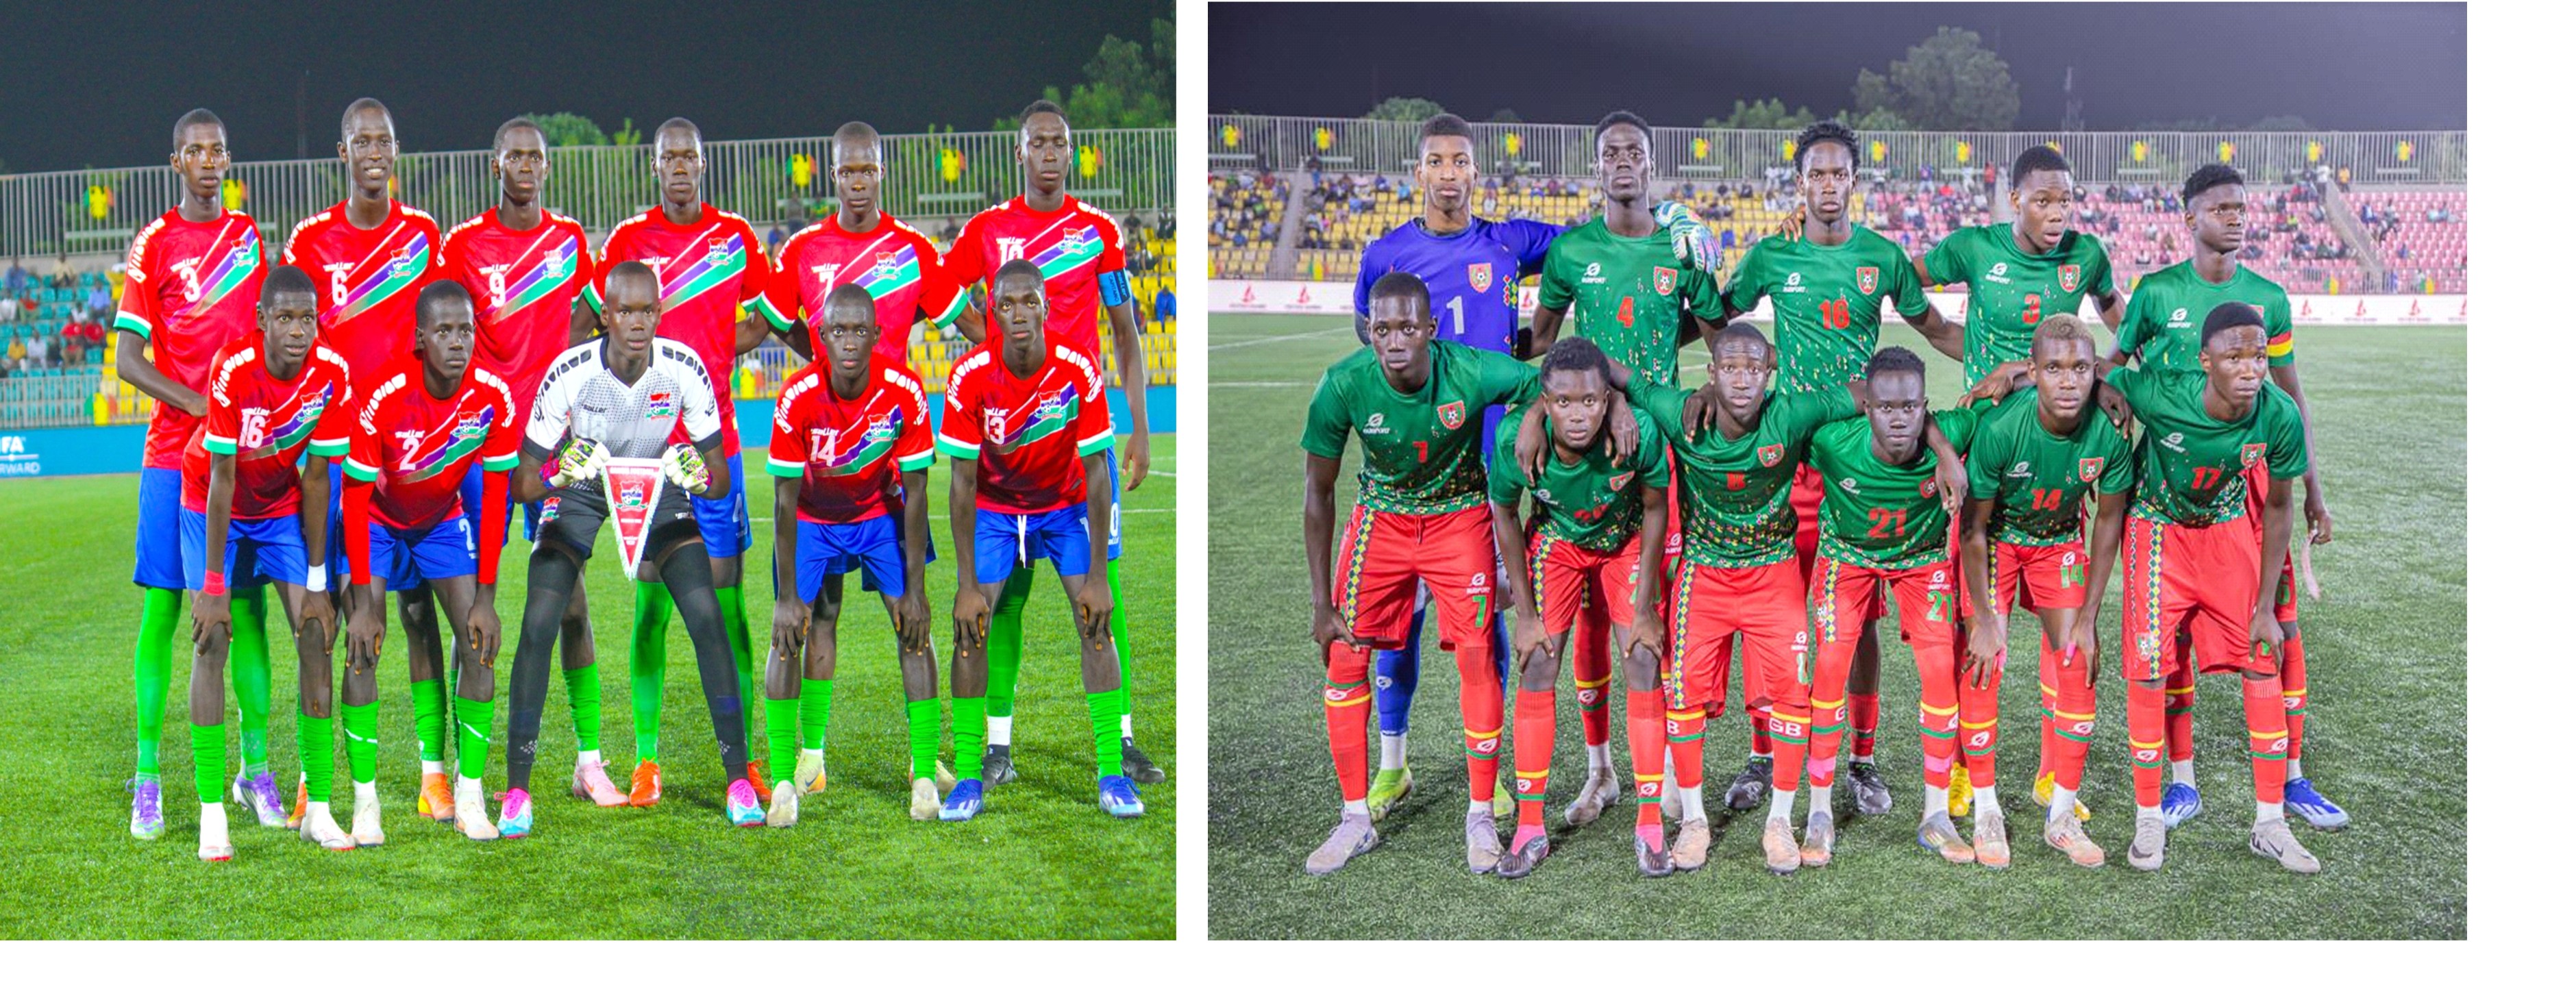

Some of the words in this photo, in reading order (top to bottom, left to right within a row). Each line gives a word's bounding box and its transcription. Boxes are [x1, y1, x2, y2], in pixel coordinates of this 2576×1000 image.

[179, 266, 200, 302] 3
[332, 270, 347, 305] 6
[489, 273, 506, 307] 9
[819, 271, 834, 308] 7
[1446, 295, 1465, 334] 1
[1616, 296, 1635, 328] 4
[2022, 293, 2042, 325] 3
[0, 436, 25, 453] FA
[238, 413, 266, 449] 16
[984, 415, 1006, 445] 13
[399, 436, 419, 471] 2
[810, 434, 836, 467] 14
[1412, 440, 1428, 463] 7
[2192, 466, 2222, 490] 17
[2031, 488, 2062, 511] 14
[458, 518, 476, 551] 2
[1868, 507, 1907, 539] 21
[2060, 564, 2085, 588] 14
[1472, 595, 1487, 627] 7
[1926, 590, 1953, 624] 21
[1769, 716, 1801, 736] GB
